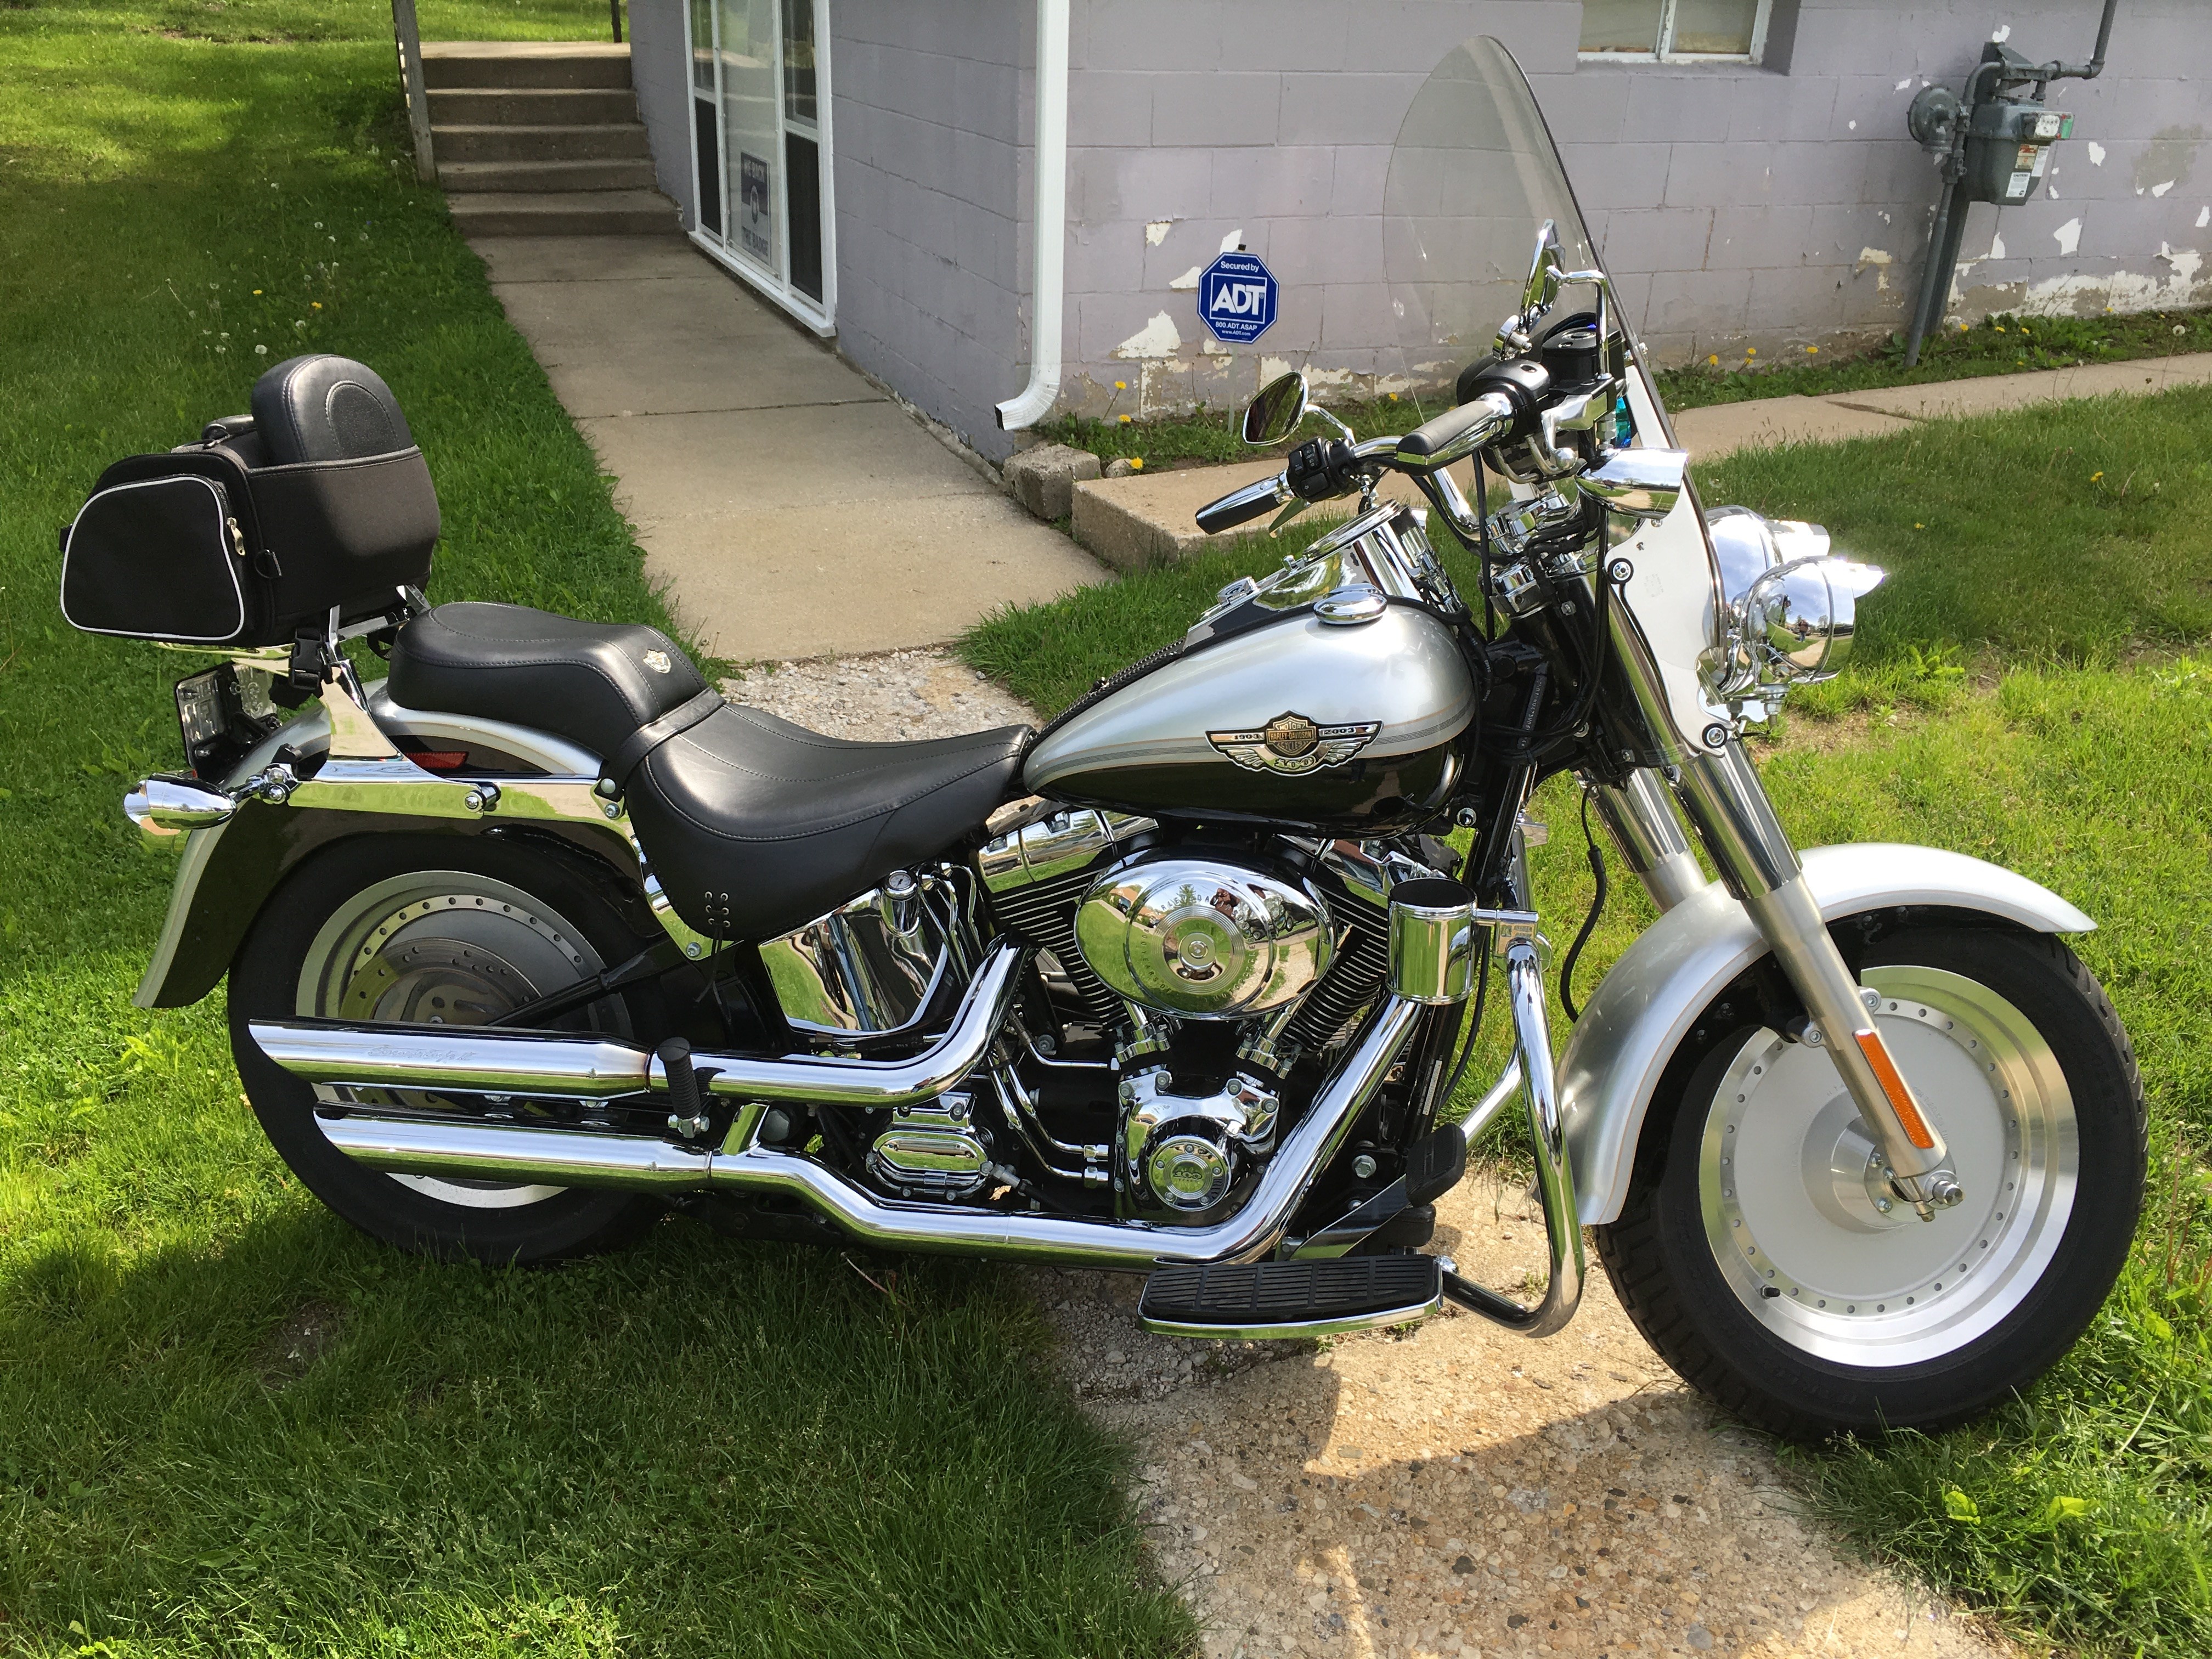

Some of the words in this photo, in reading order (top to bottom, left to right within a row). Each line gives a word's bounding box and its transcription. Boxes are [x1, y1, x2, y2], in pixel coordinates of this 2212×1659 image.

[1220, 261, 1250, 270] Secured
[1250, 263, 1260, 273] by
[1211, 283, 1266, 315] ADT
[1279, 722, 1302, 730] MOTOR
[1324, 727, 1356, 735] 2003
[1270, 730, 1312, 741] HARLEY-DAVIDSON
[1280, 741, 1304, 751] CYCLES
[1141, 950, 1159, 983] YEARS
